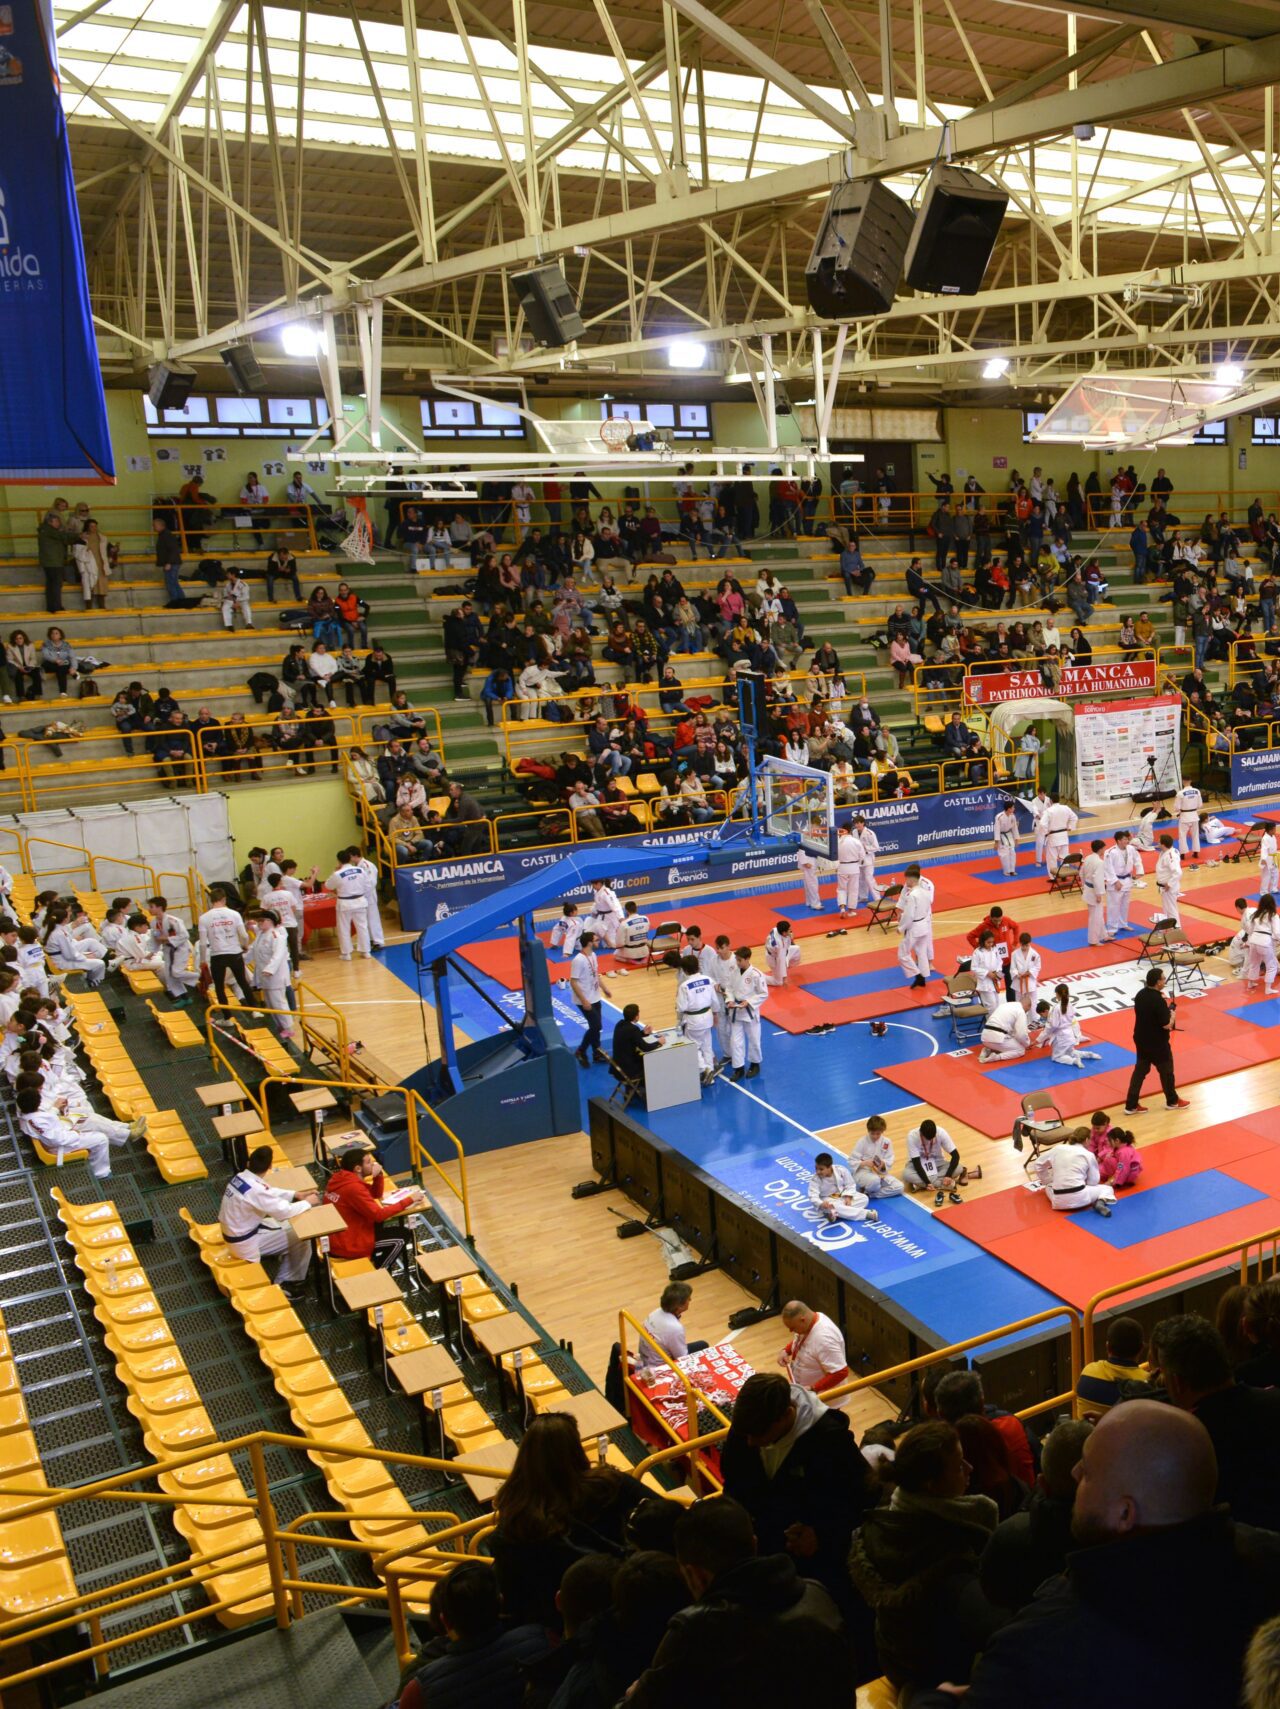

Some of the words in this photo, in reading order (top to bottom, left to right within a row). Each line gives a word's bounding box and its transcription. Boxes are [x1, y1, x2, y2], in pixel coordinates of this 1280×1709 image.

[989, 684, 1055, 701] PATRIMONIO
[1059, 684, 1073, 694] DE
[1076, 682, 1089, 693] LA
[1091, 676, 1151, 692] HUMANIDAD
[943, 795, 984, 808] CASTILLA
[986, 794, 993, 803] Y
[851, 802, 919, 820] SALAMANCA
[412, 859, 504, 884] SALAMANCA
[998, 947, 1007, 955] 20
[924, 1161, 934, 1171] 18
